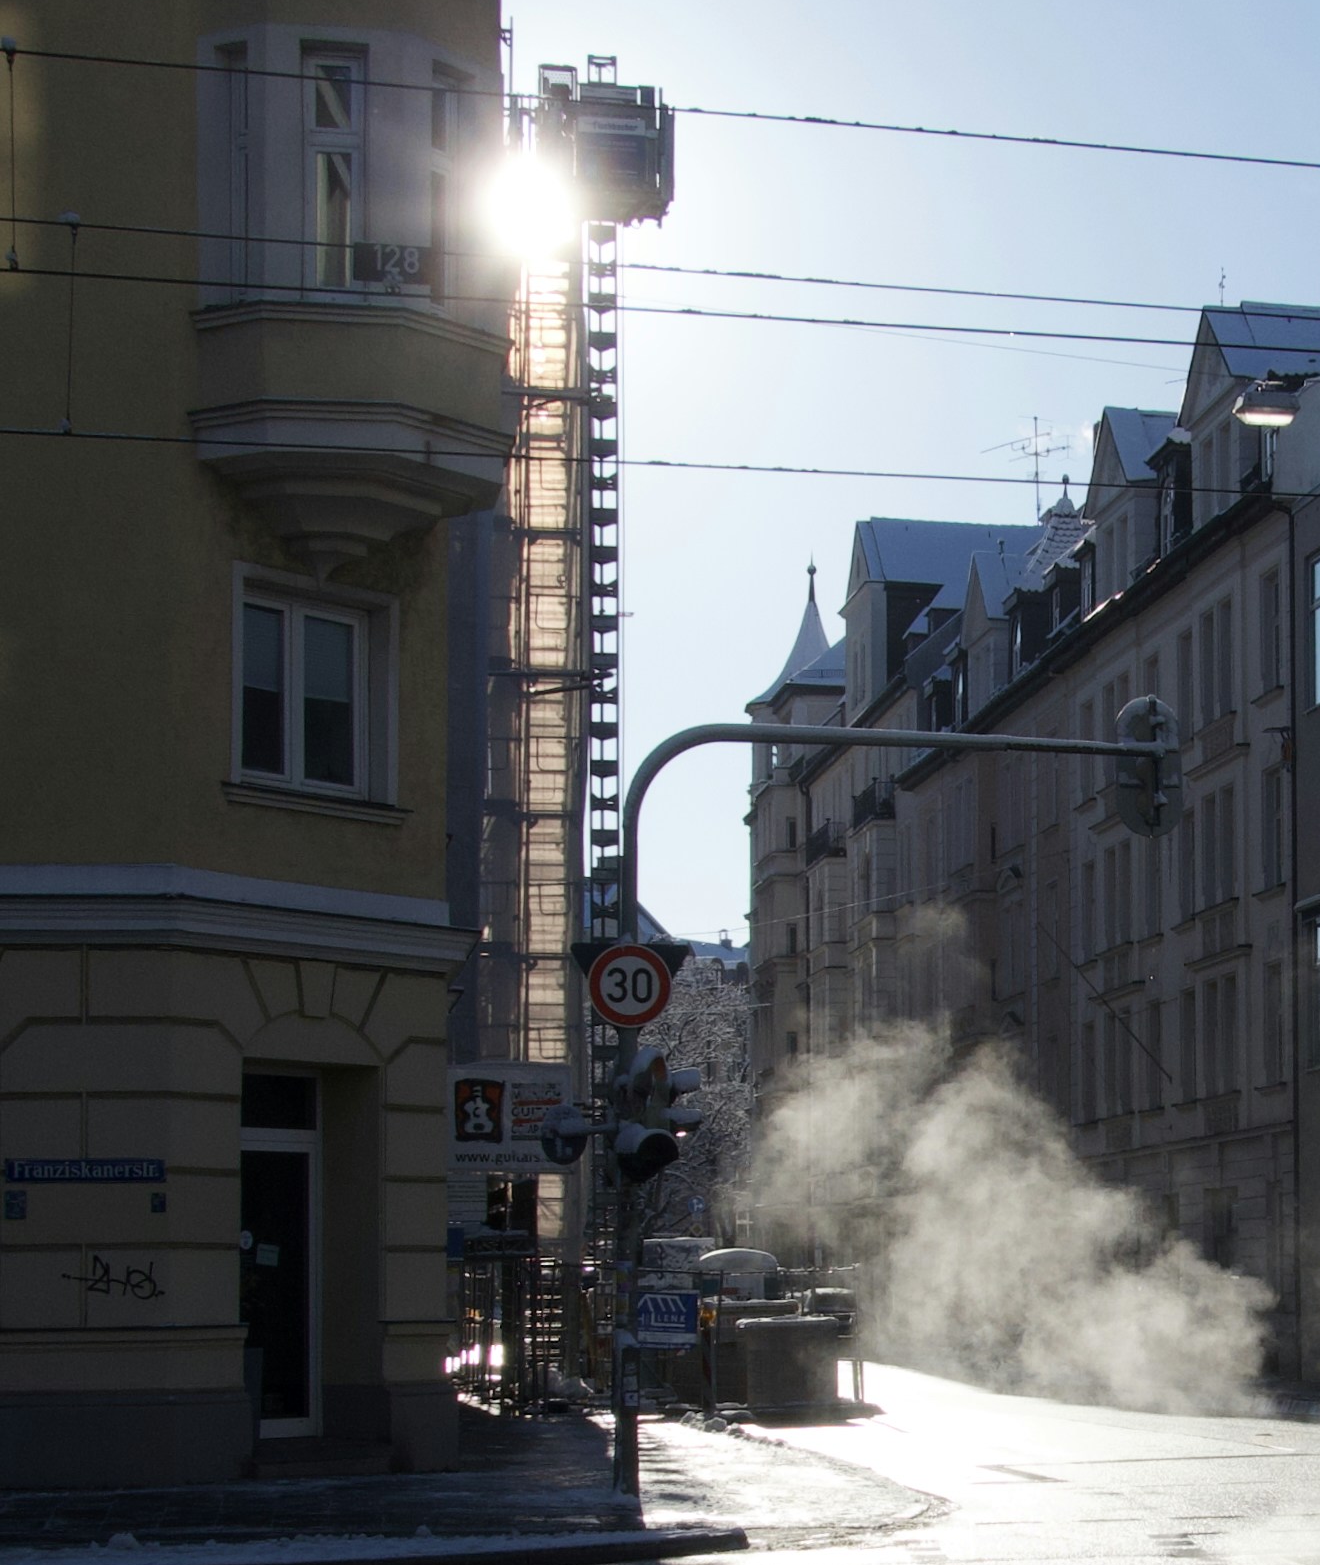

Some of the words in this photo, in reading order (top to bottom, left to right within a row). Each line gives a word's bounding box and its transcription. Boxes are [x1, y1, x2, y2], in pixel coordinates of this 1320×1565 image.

[374, 244, 420, 274] 128
[606, 967, 653, 1004] 30
[13, 1161, 160, 1179] Franziskanerstr.
